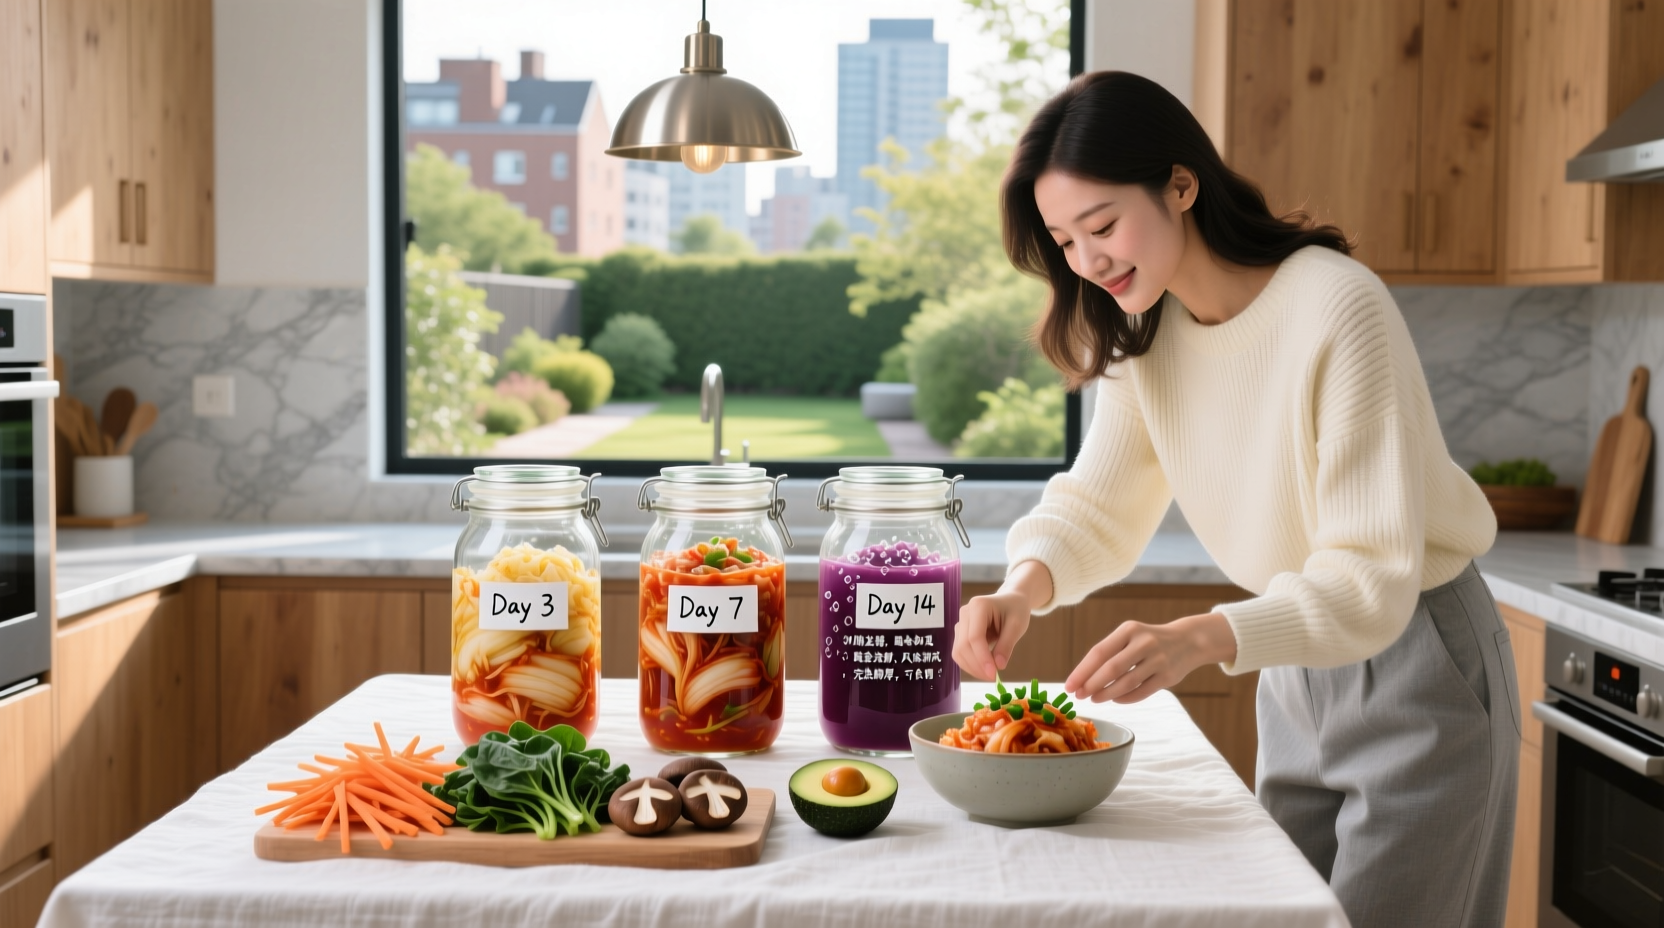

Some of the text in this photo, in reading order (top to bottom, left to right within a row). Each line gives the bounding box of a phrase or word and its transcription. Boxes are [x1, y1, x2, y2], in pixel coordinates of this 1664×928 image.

[492, 592, 555, 624] Day 3
[679, 595, 744, 628] Day 7
[867, 593, 936, 625] Day 14
